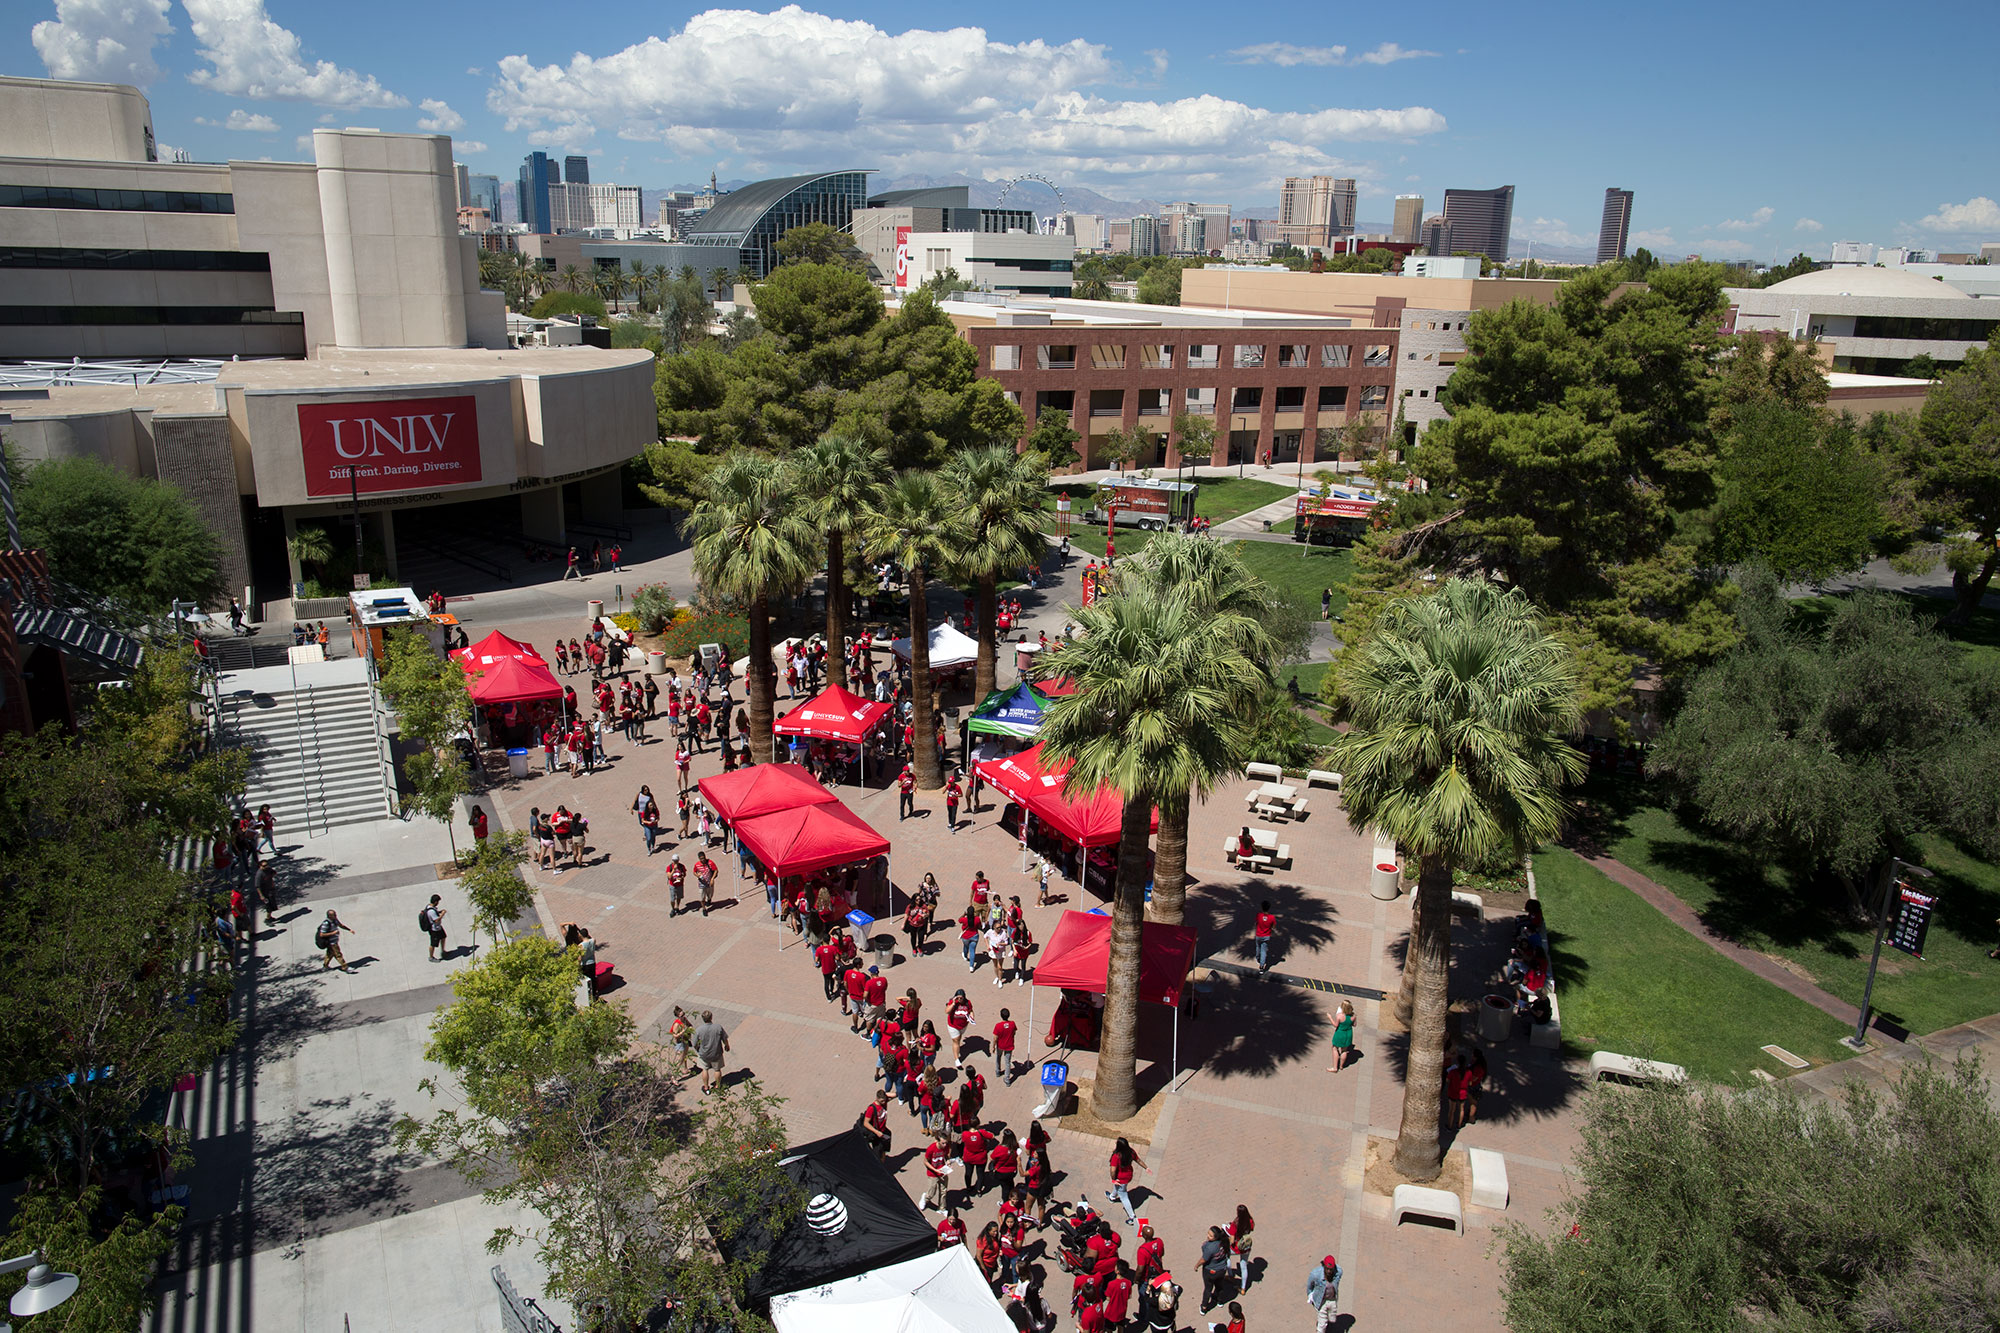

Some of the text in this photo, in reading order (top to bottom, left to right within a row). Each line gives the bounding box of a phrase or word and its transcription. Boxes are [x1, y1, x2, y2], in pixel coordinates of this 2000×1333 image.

[326, 412, 456, 458] UNLV
[329, 460, 462, 480] Diffrent. Daring. Diverse.
[336, 492, 444, 510] LEE BUSINESS SCHOOL
